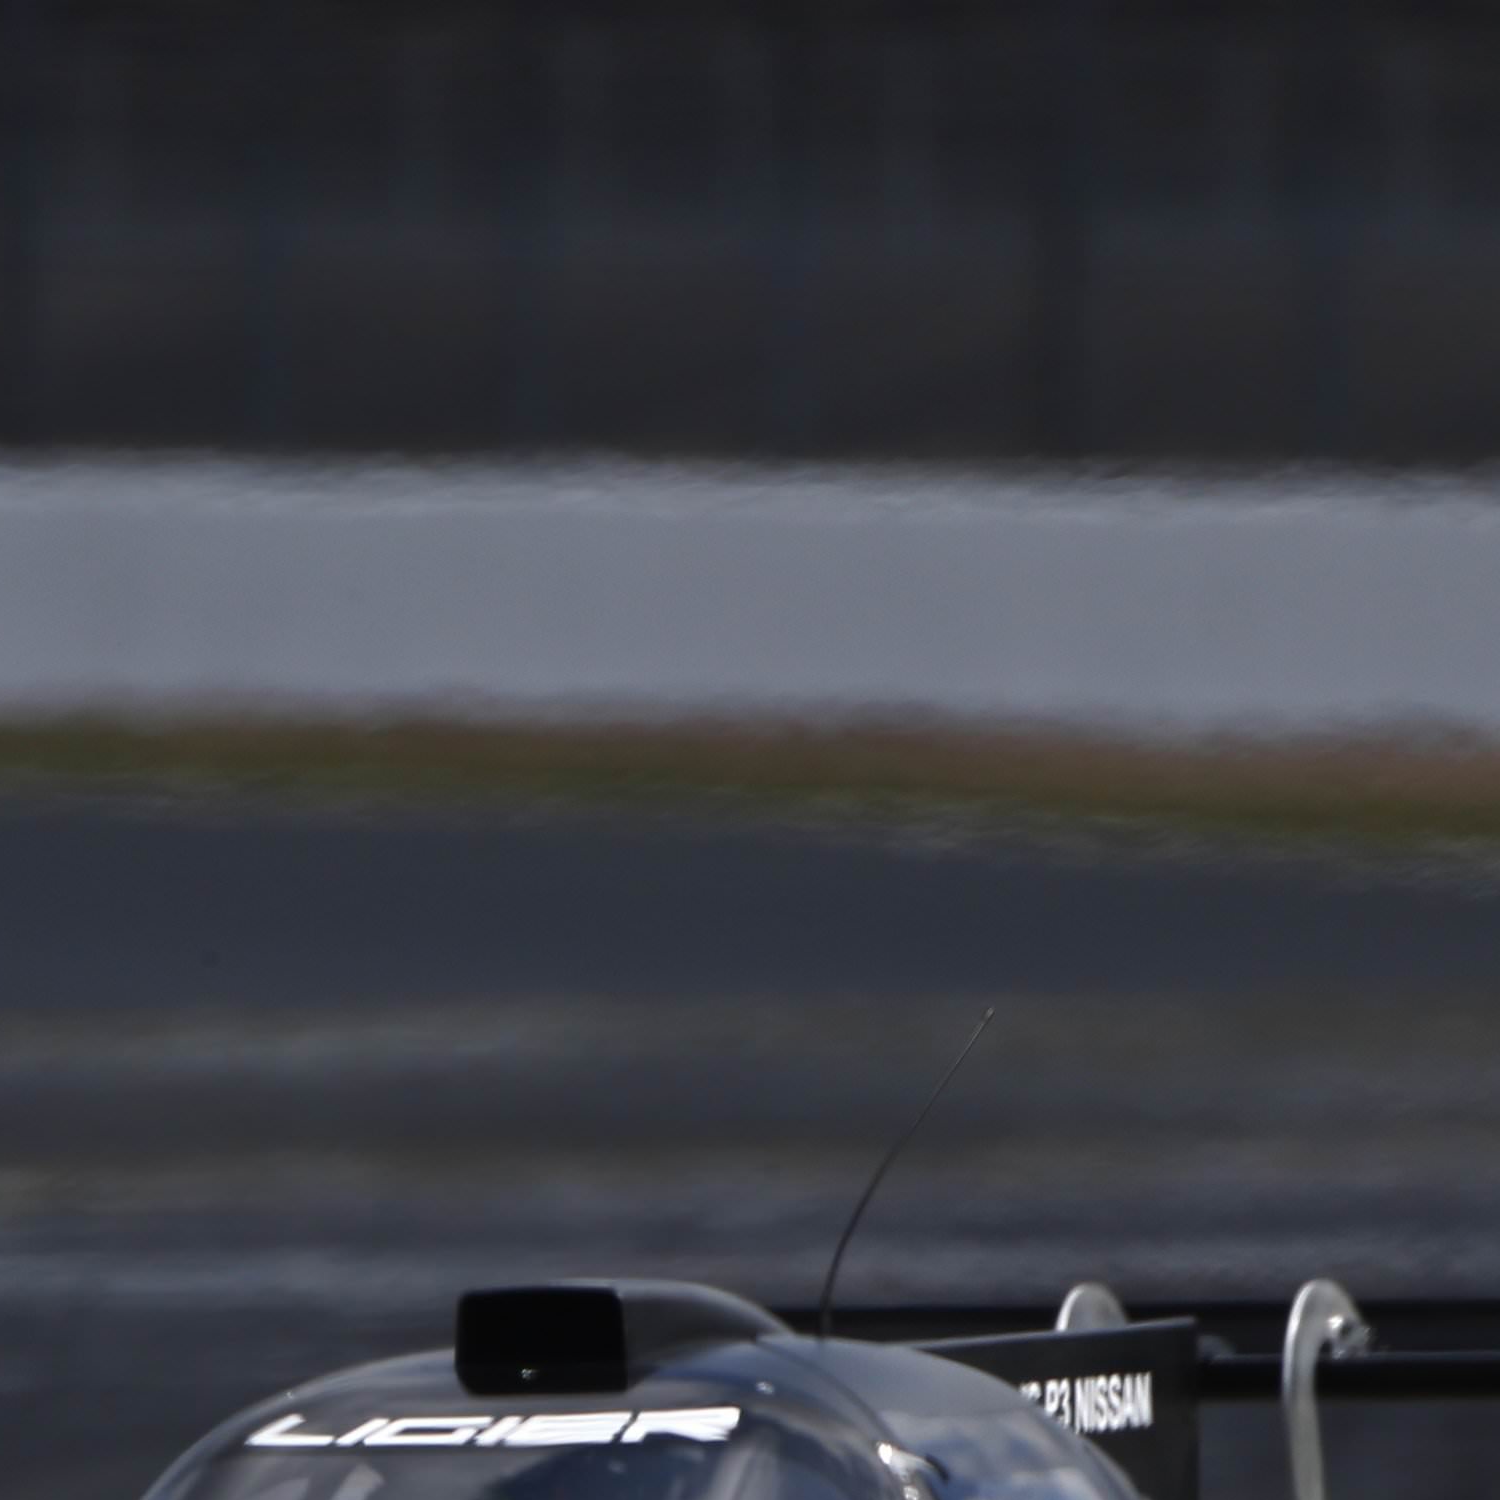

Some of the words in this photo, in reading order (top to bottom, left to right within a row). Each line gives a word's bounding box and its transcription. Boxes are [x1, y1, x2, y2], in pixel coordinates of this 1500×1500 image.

[245, 1407, 740, 1446] LIGIER
[1044, 1378, 1070, 1428] P3
[1074, 1371, 1153, 1434] NISSAN
